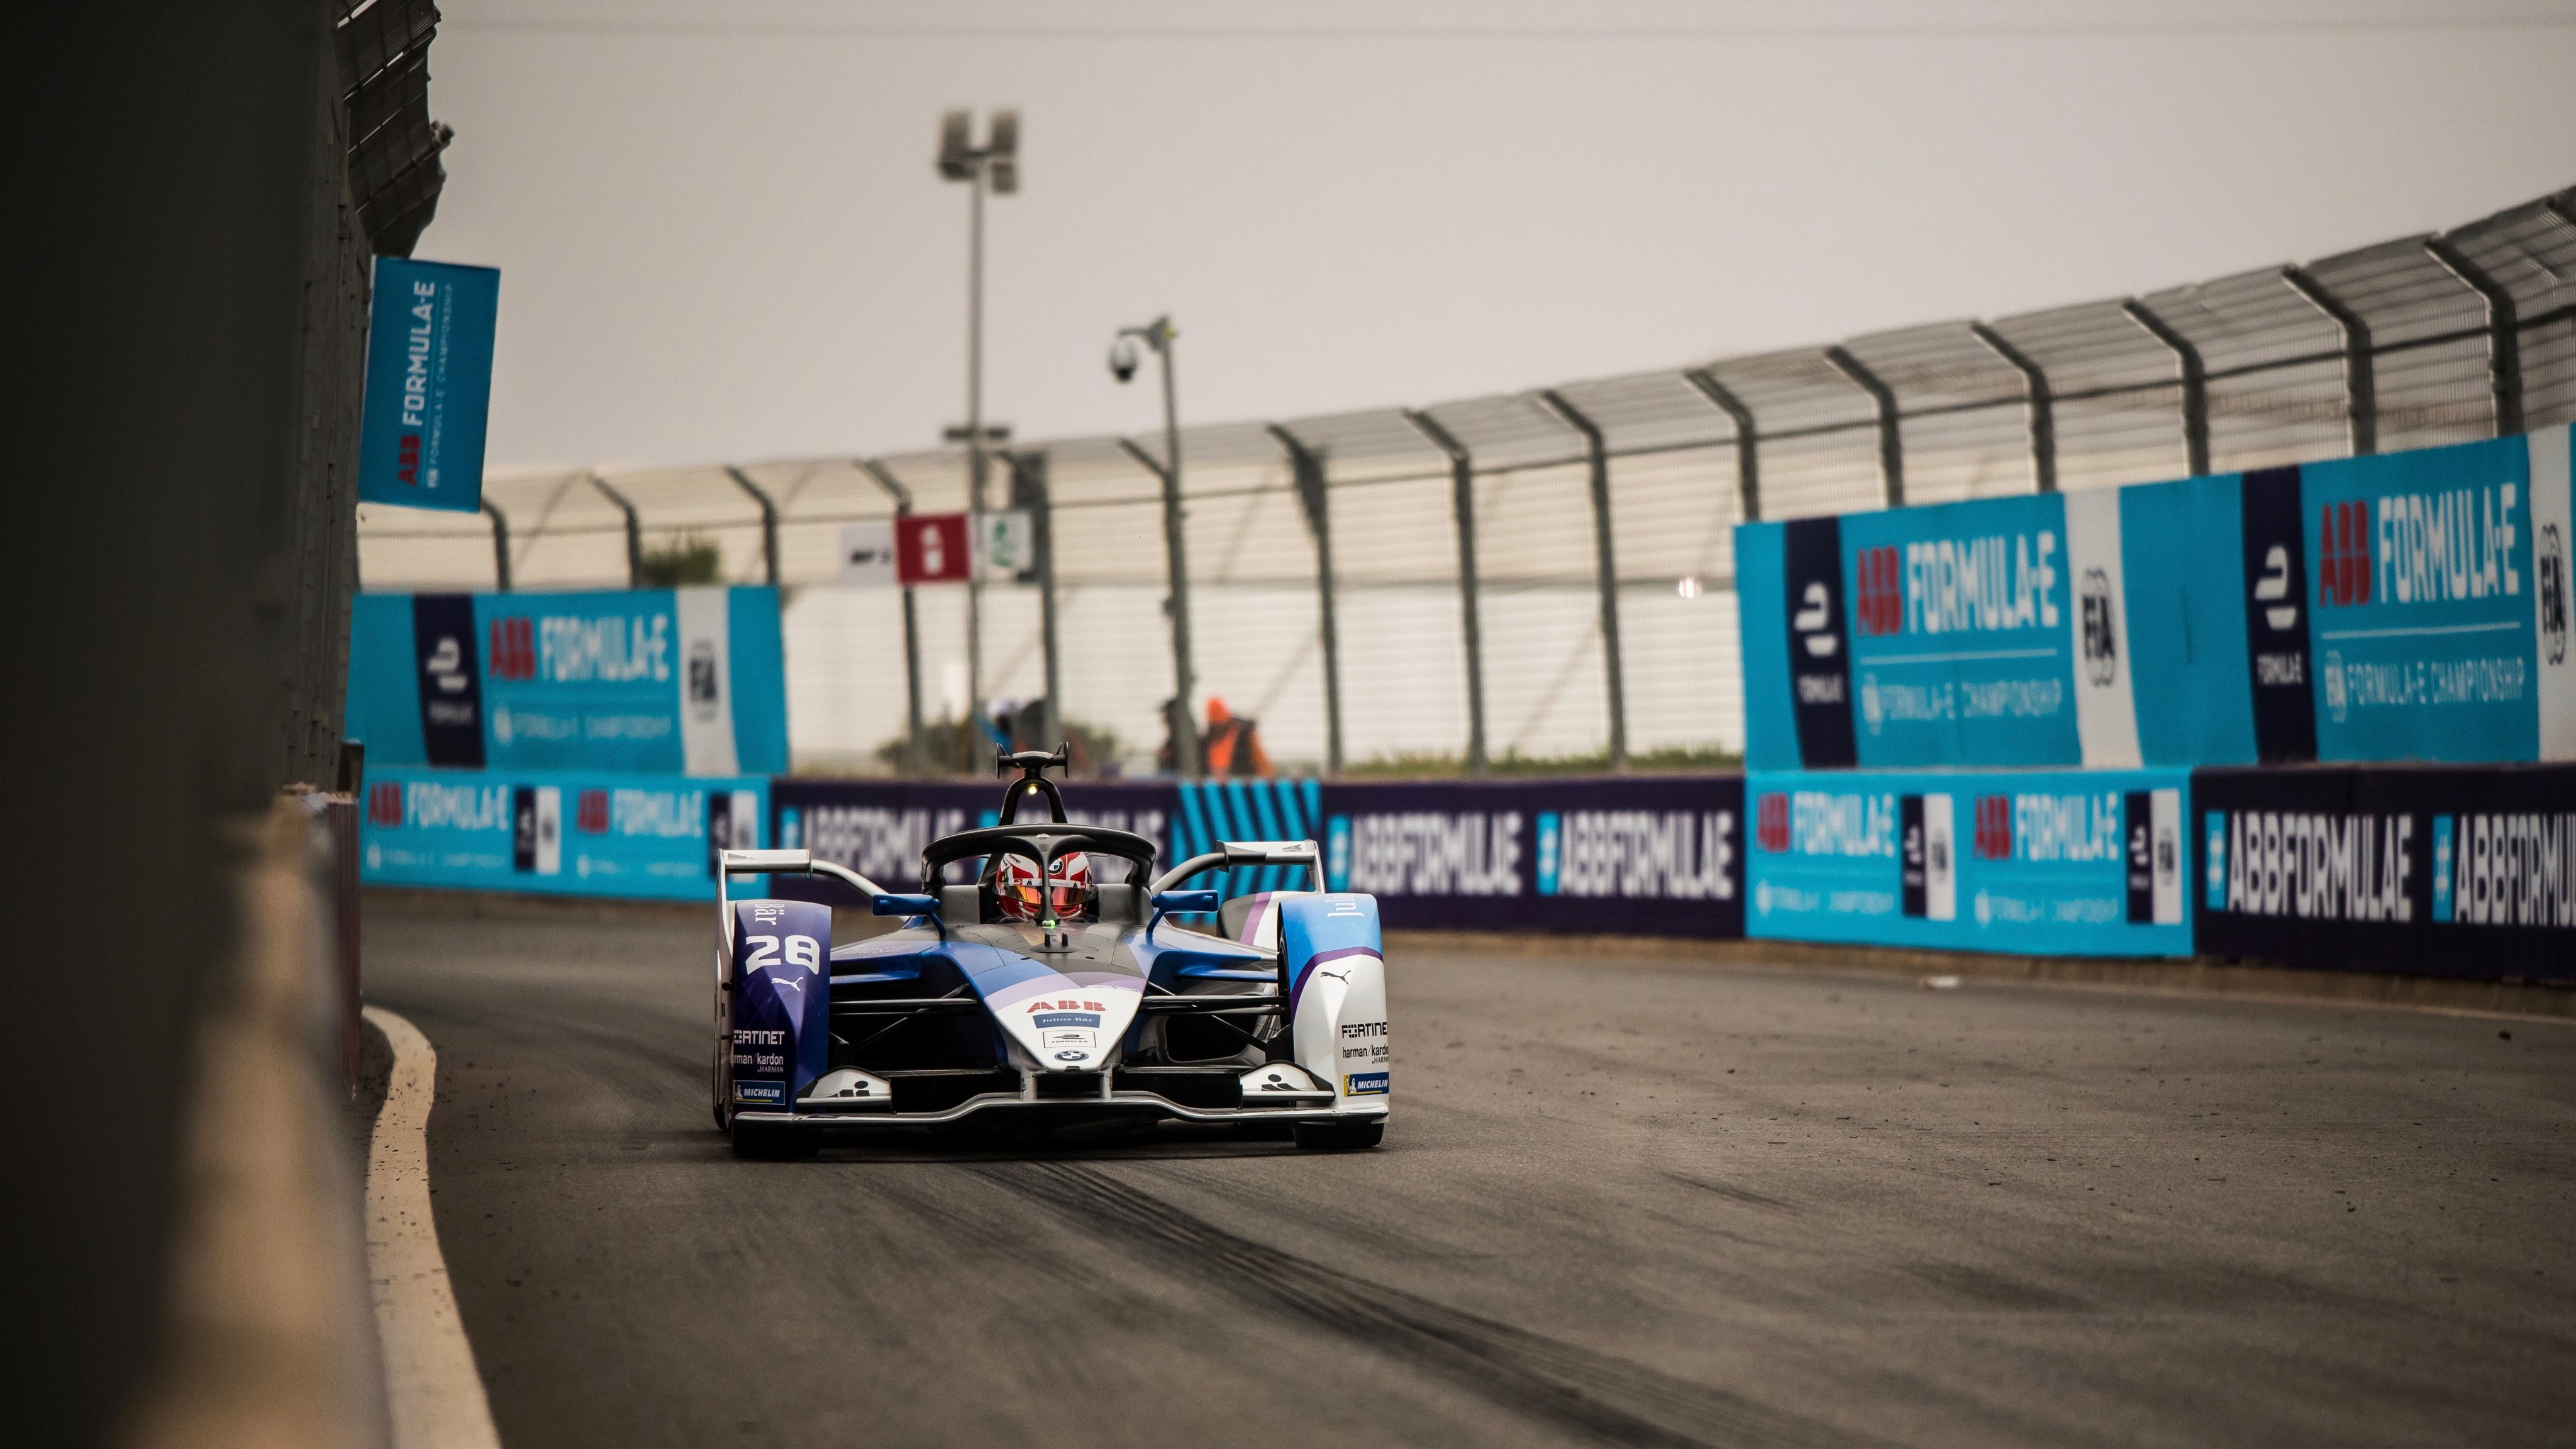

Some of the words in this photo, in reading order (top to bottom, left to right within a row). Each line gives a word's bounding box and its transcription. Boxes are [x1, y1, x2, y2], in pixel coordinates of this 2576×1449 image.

[397, 434, 421, 487] ABB
[2319, 500, 2372, 608] ABB
[1857, 545, 1904, 637] ABB
[489, 616, 536, 681] ABB
[1973, 794, 2011, 860] ABB
[745, 935, 821, 976] 28
[1026, 1000, 1106, 1013] ABB
[734, 1030, 786, 1045] ORTINET
[1341, 1021, 1388, 1039] FORTINE
[1342, 1043, 1389, 1058] harman/kardo
[743, 1088, 780, 1097] MICHELIN
[1357, 1079, 1389, 1090] MICHELIN
